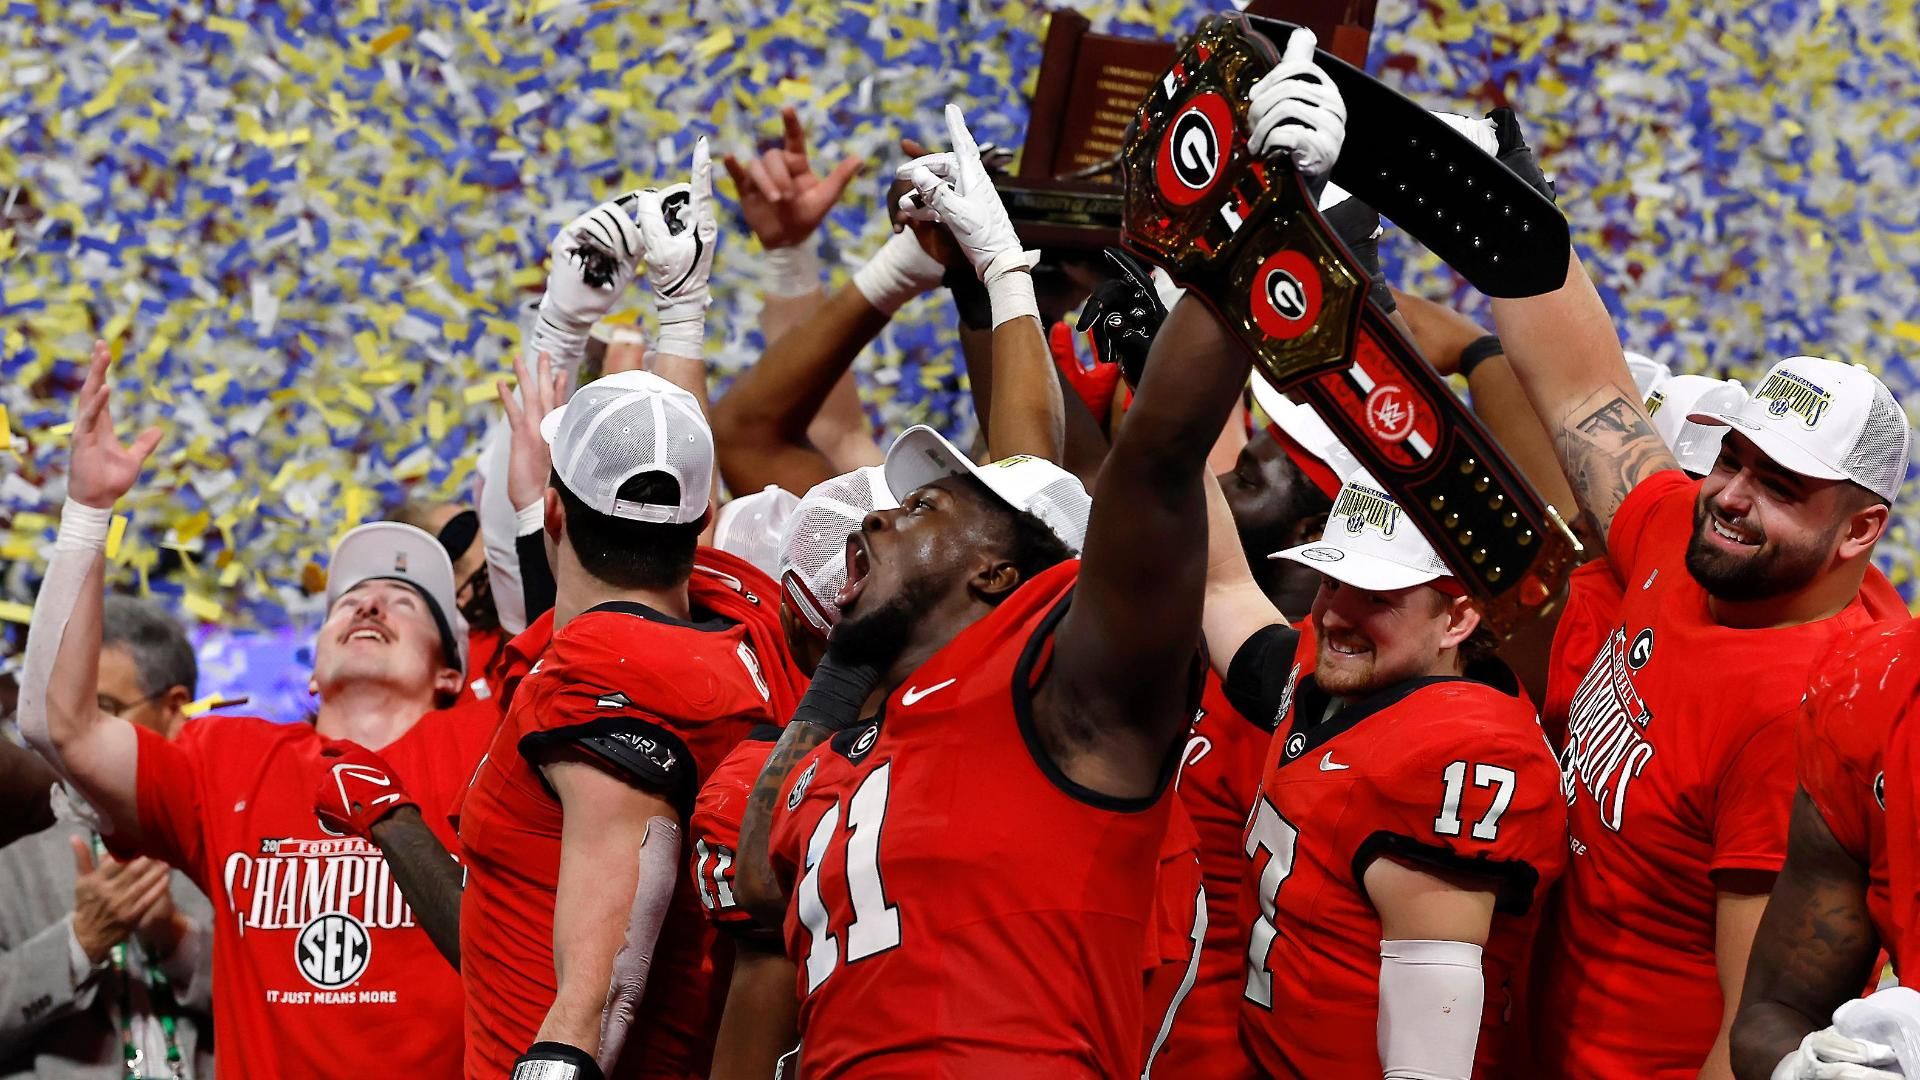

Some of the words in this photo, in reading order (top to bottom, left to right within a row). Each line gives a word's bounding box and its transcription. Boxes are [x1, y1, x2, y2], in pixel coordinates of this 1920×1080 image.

[1170, 109, 1219, 190] G
[1265, 268, 1307, 321] G
[1756, 374, 1829, 427] CHAMPIONS
[1333, 488, 1402, 536] CHAMPIONS
[1568, 629, 1653, 832] CHAMPIONS
[1434, 760, 1516, 841] 17
[299, 839, 382, 854] FOOTBAL
[696, 838, 736, 909] 11
[798, 760, 901, 996] 11
[224, 852, 416, 938] CHAMPIO
[1245, 785, 1300, 1013] 7
[301, 916, 365, 985] SEC
[266, 990, 278, 1002] IT
[280, 991, 312, 1004] JUST
[313, 991, 357, 1004] MEANS
[358, 991, 397, 1003] MORE
